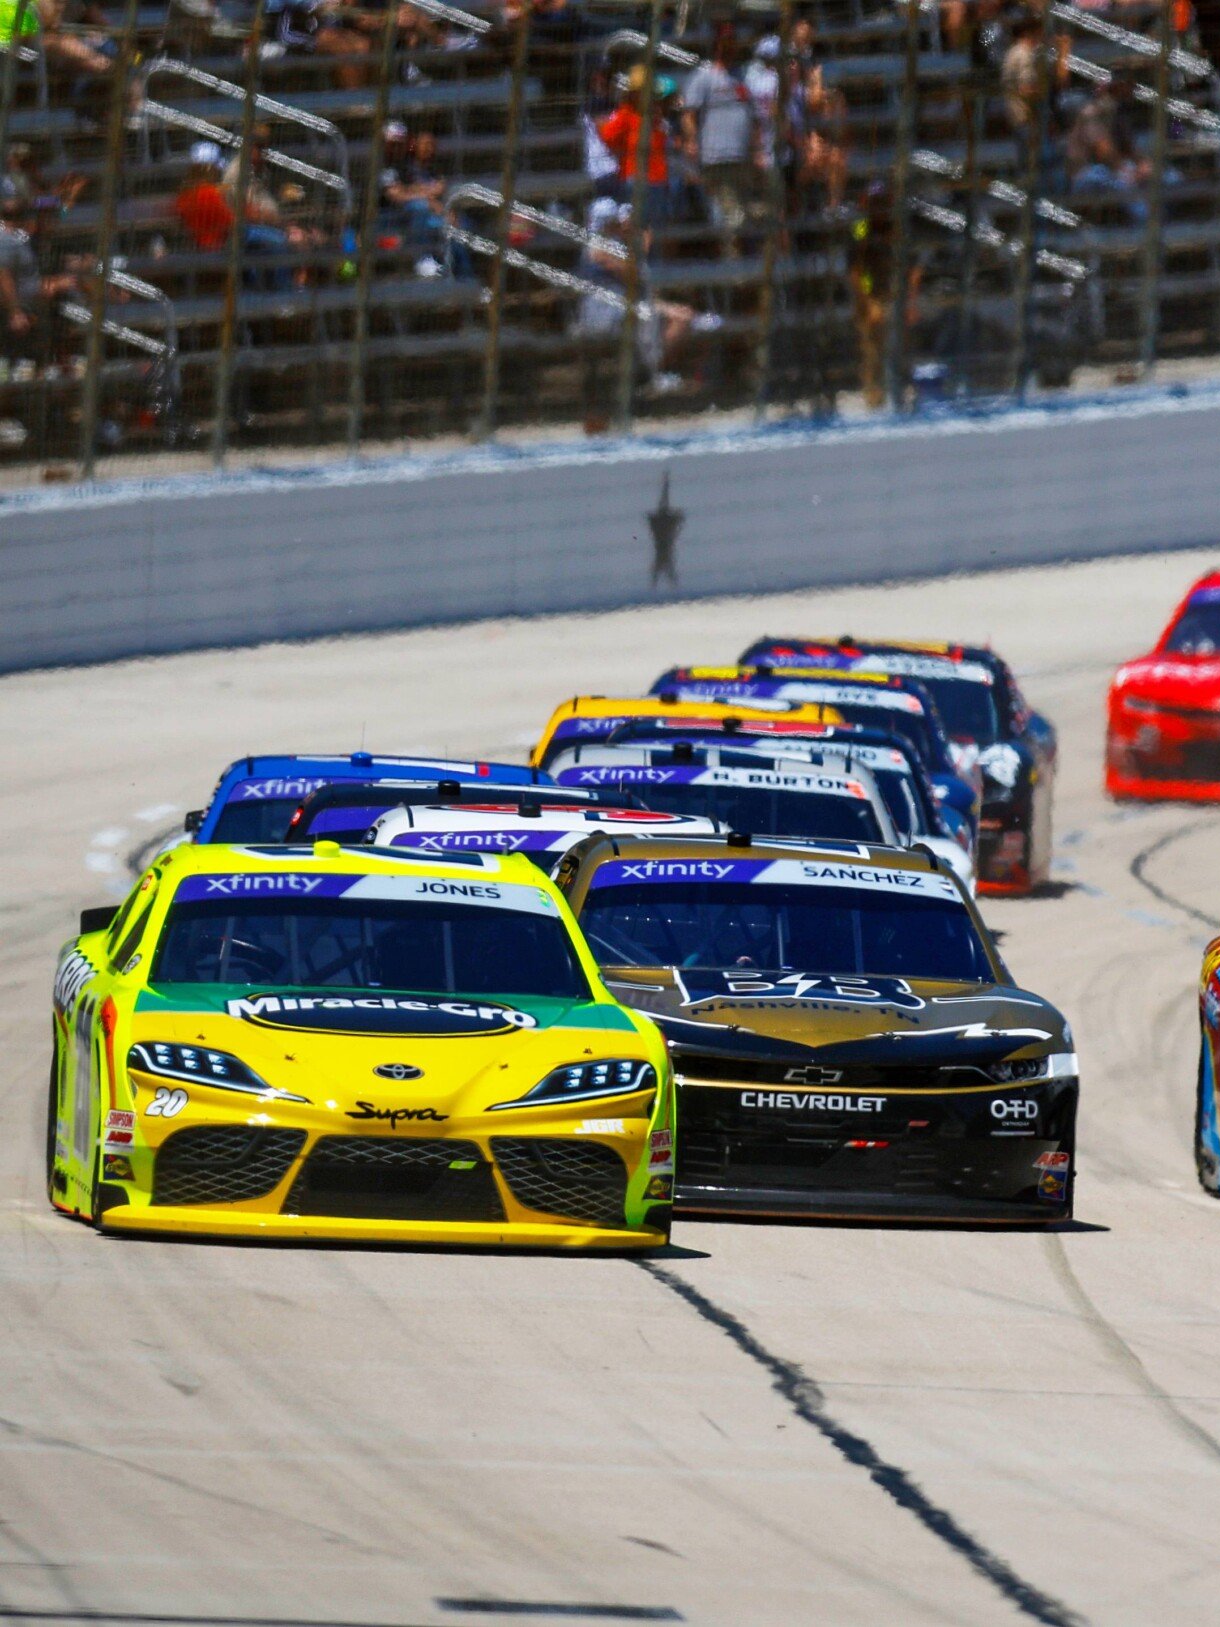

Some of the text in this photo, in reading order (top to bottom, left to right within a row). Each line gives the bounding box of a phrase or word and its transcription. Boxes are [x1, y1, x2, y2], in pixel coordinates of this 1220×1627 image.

[578, 767, 676, 785] xfinity
[748, 774, 850, 791] BURTON
[420, 832, 529, 850] xfinity
[206, 873, 501, 899] xfinity JONES
[621, 859, 925, 888] xfinity SANCHEZ
[227, 995, 538, 1029] Miracle-Gro
[145, 1086, 188, 1118] 20
[740, 1091, 888, 1112] CHEVROLET
[344, 1101, 450, 1130] Supra
